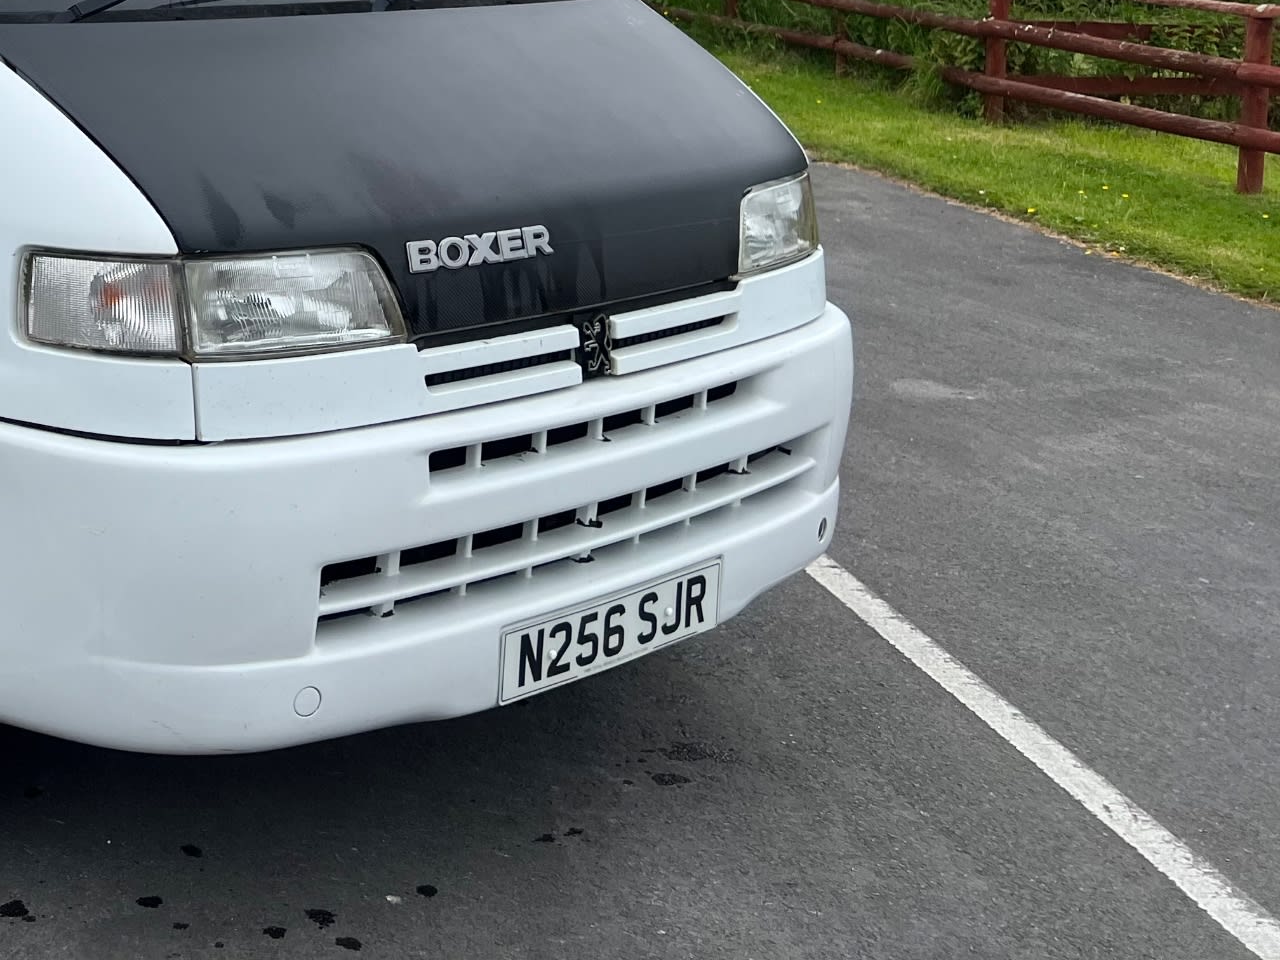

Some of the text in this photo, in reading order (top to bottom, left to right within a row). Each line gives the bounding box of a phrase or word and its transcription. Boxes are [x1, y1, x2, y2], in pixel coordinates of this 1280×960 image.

[405, 224, 555, 274] BOXER
[518, 574, 707, 688] N256 SJR
